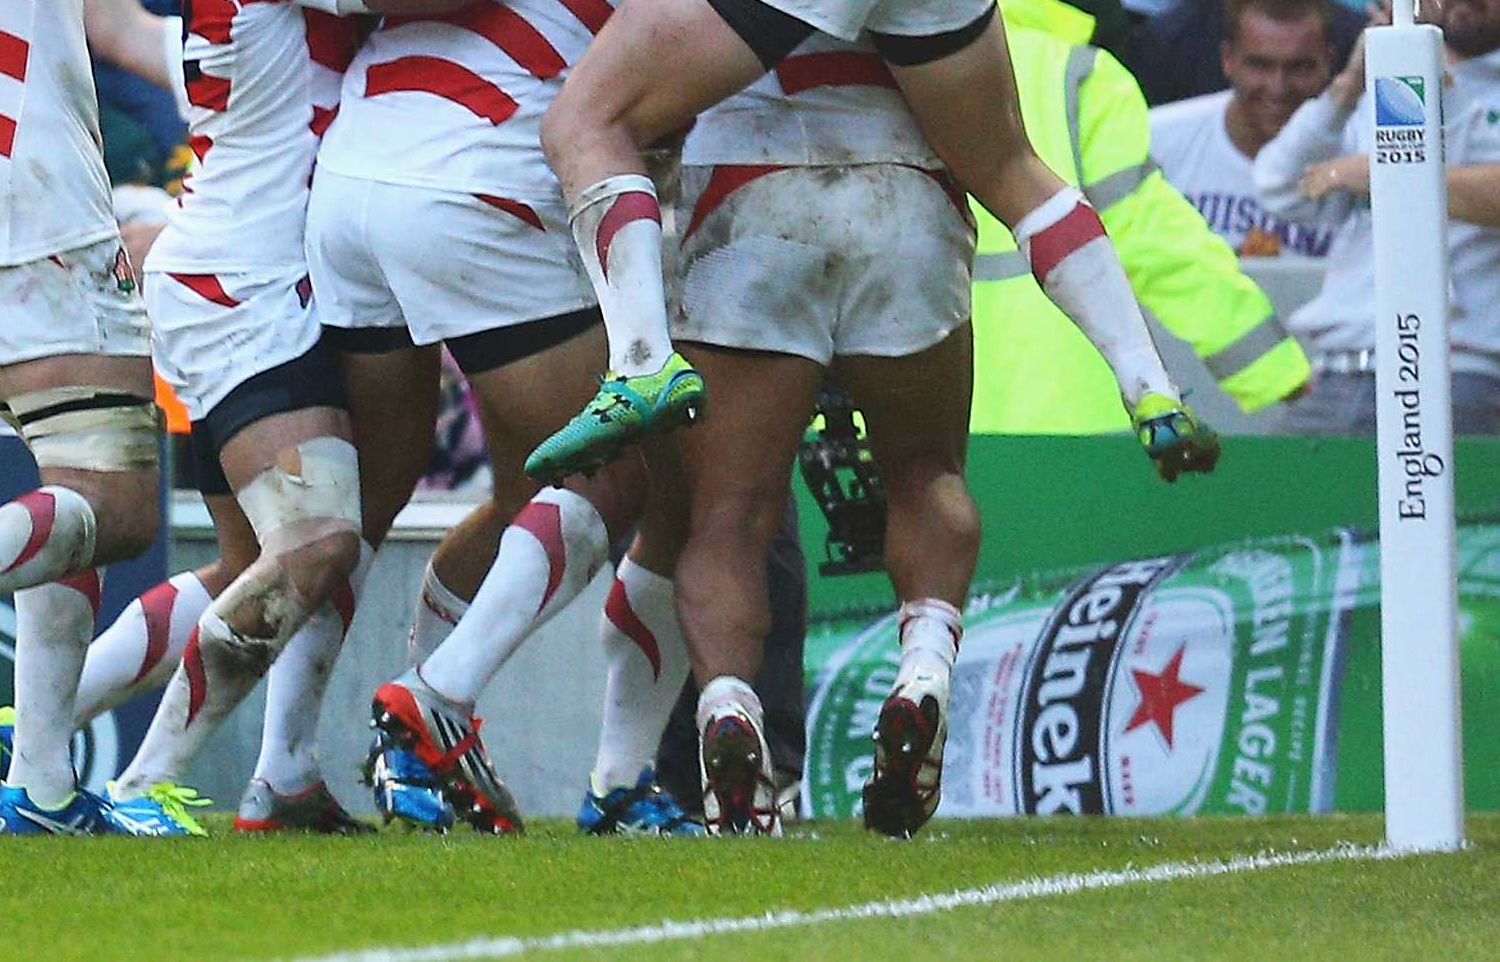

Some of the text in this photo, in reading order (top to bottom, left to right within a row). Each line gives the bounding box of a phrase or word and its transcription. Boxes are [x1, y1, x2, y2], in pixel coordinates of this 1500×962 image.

[1375, 128, 1425, 143] RUGBY
[1376, 150, 1426, 164] 2015
[1395, 313, 1445, 522] England 2015
[1226, 664, 1285, 817] LAGER
